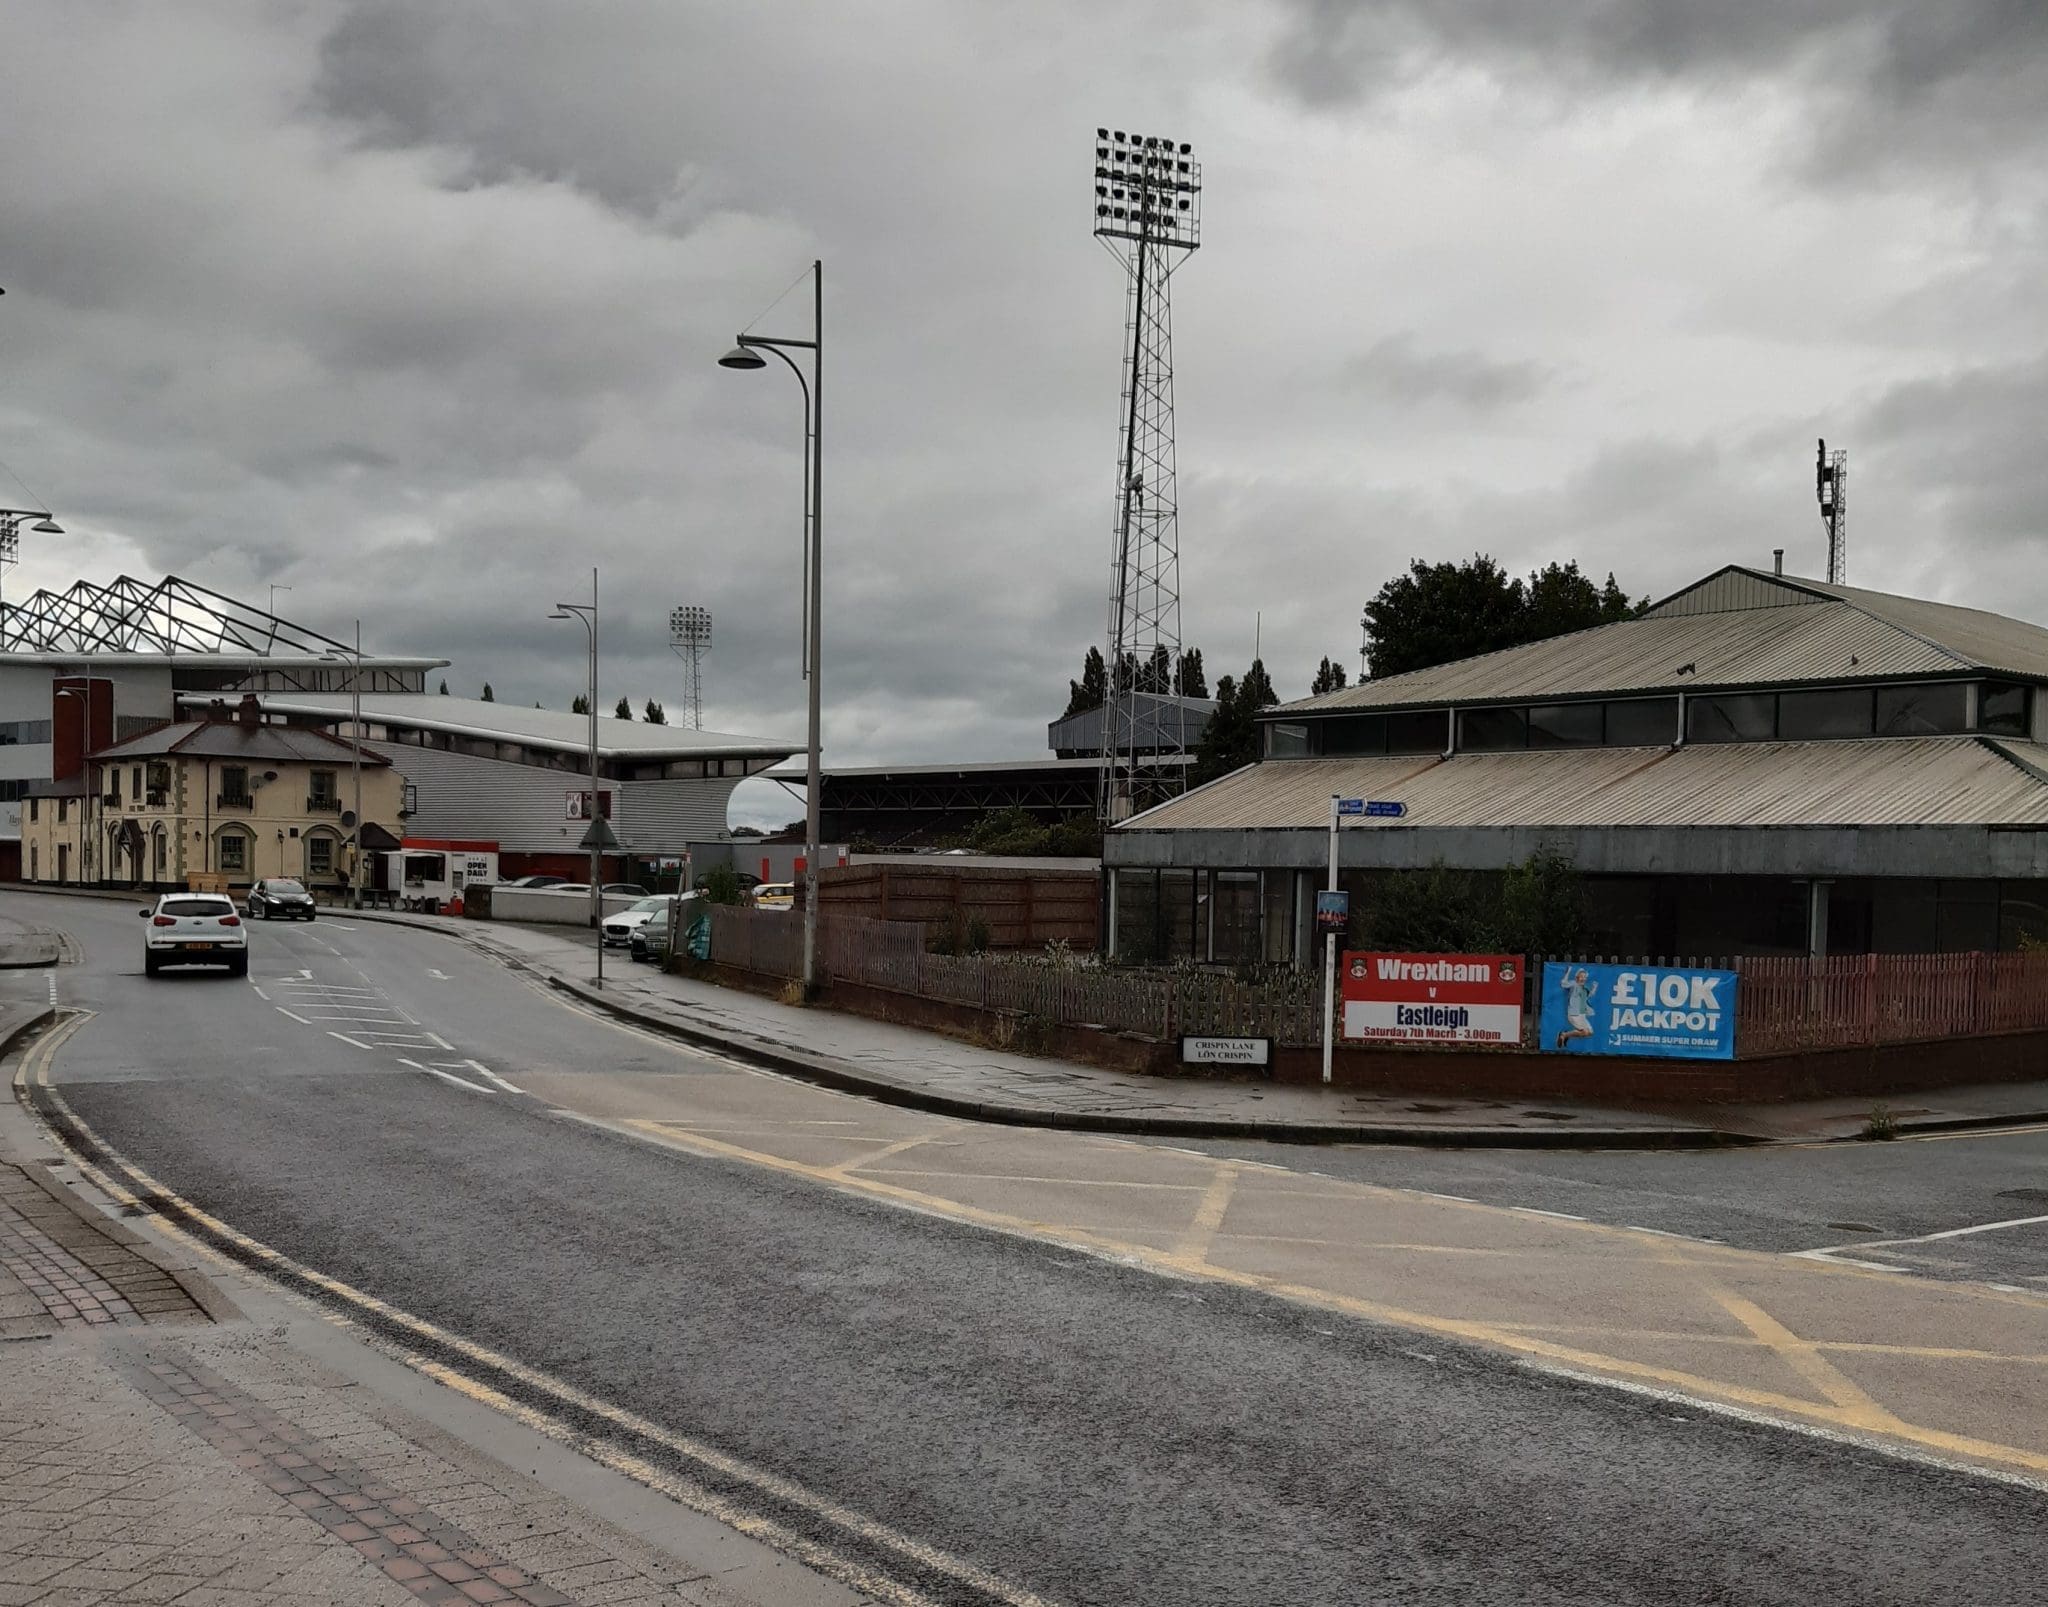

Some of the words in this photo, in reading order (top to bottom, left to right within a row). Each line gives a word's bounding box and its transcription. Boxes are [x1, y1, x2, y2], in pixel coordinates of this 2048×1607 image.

[1377, 958, 1490, 982] Wrexham
[1429, 987, 1437, 998] v
[1611, 972, 1720, 1009] £10K
[1397, 1004, 1469, 1029] Eastleigh
[1609, 1008, 1720, 1031] JACKPOT
[1364, 1026, 1408, 1038] Saturday
[1409, 1027, 1424, 1038] 7th
[1426, 1028, 1457, 1039] Macrh
[1464, 1029, 1501, 1041] 3.00pm
[1622, 1034, 1660, 1043] SUMMER
[1662, 1036, 1690, 1045] SUPER
[1691, 1038, 1719, 1046] DRAW
[1195, 1041, 1230, 1049] CRISPIN
[1232, 1042, 1256, 1050] LANE
